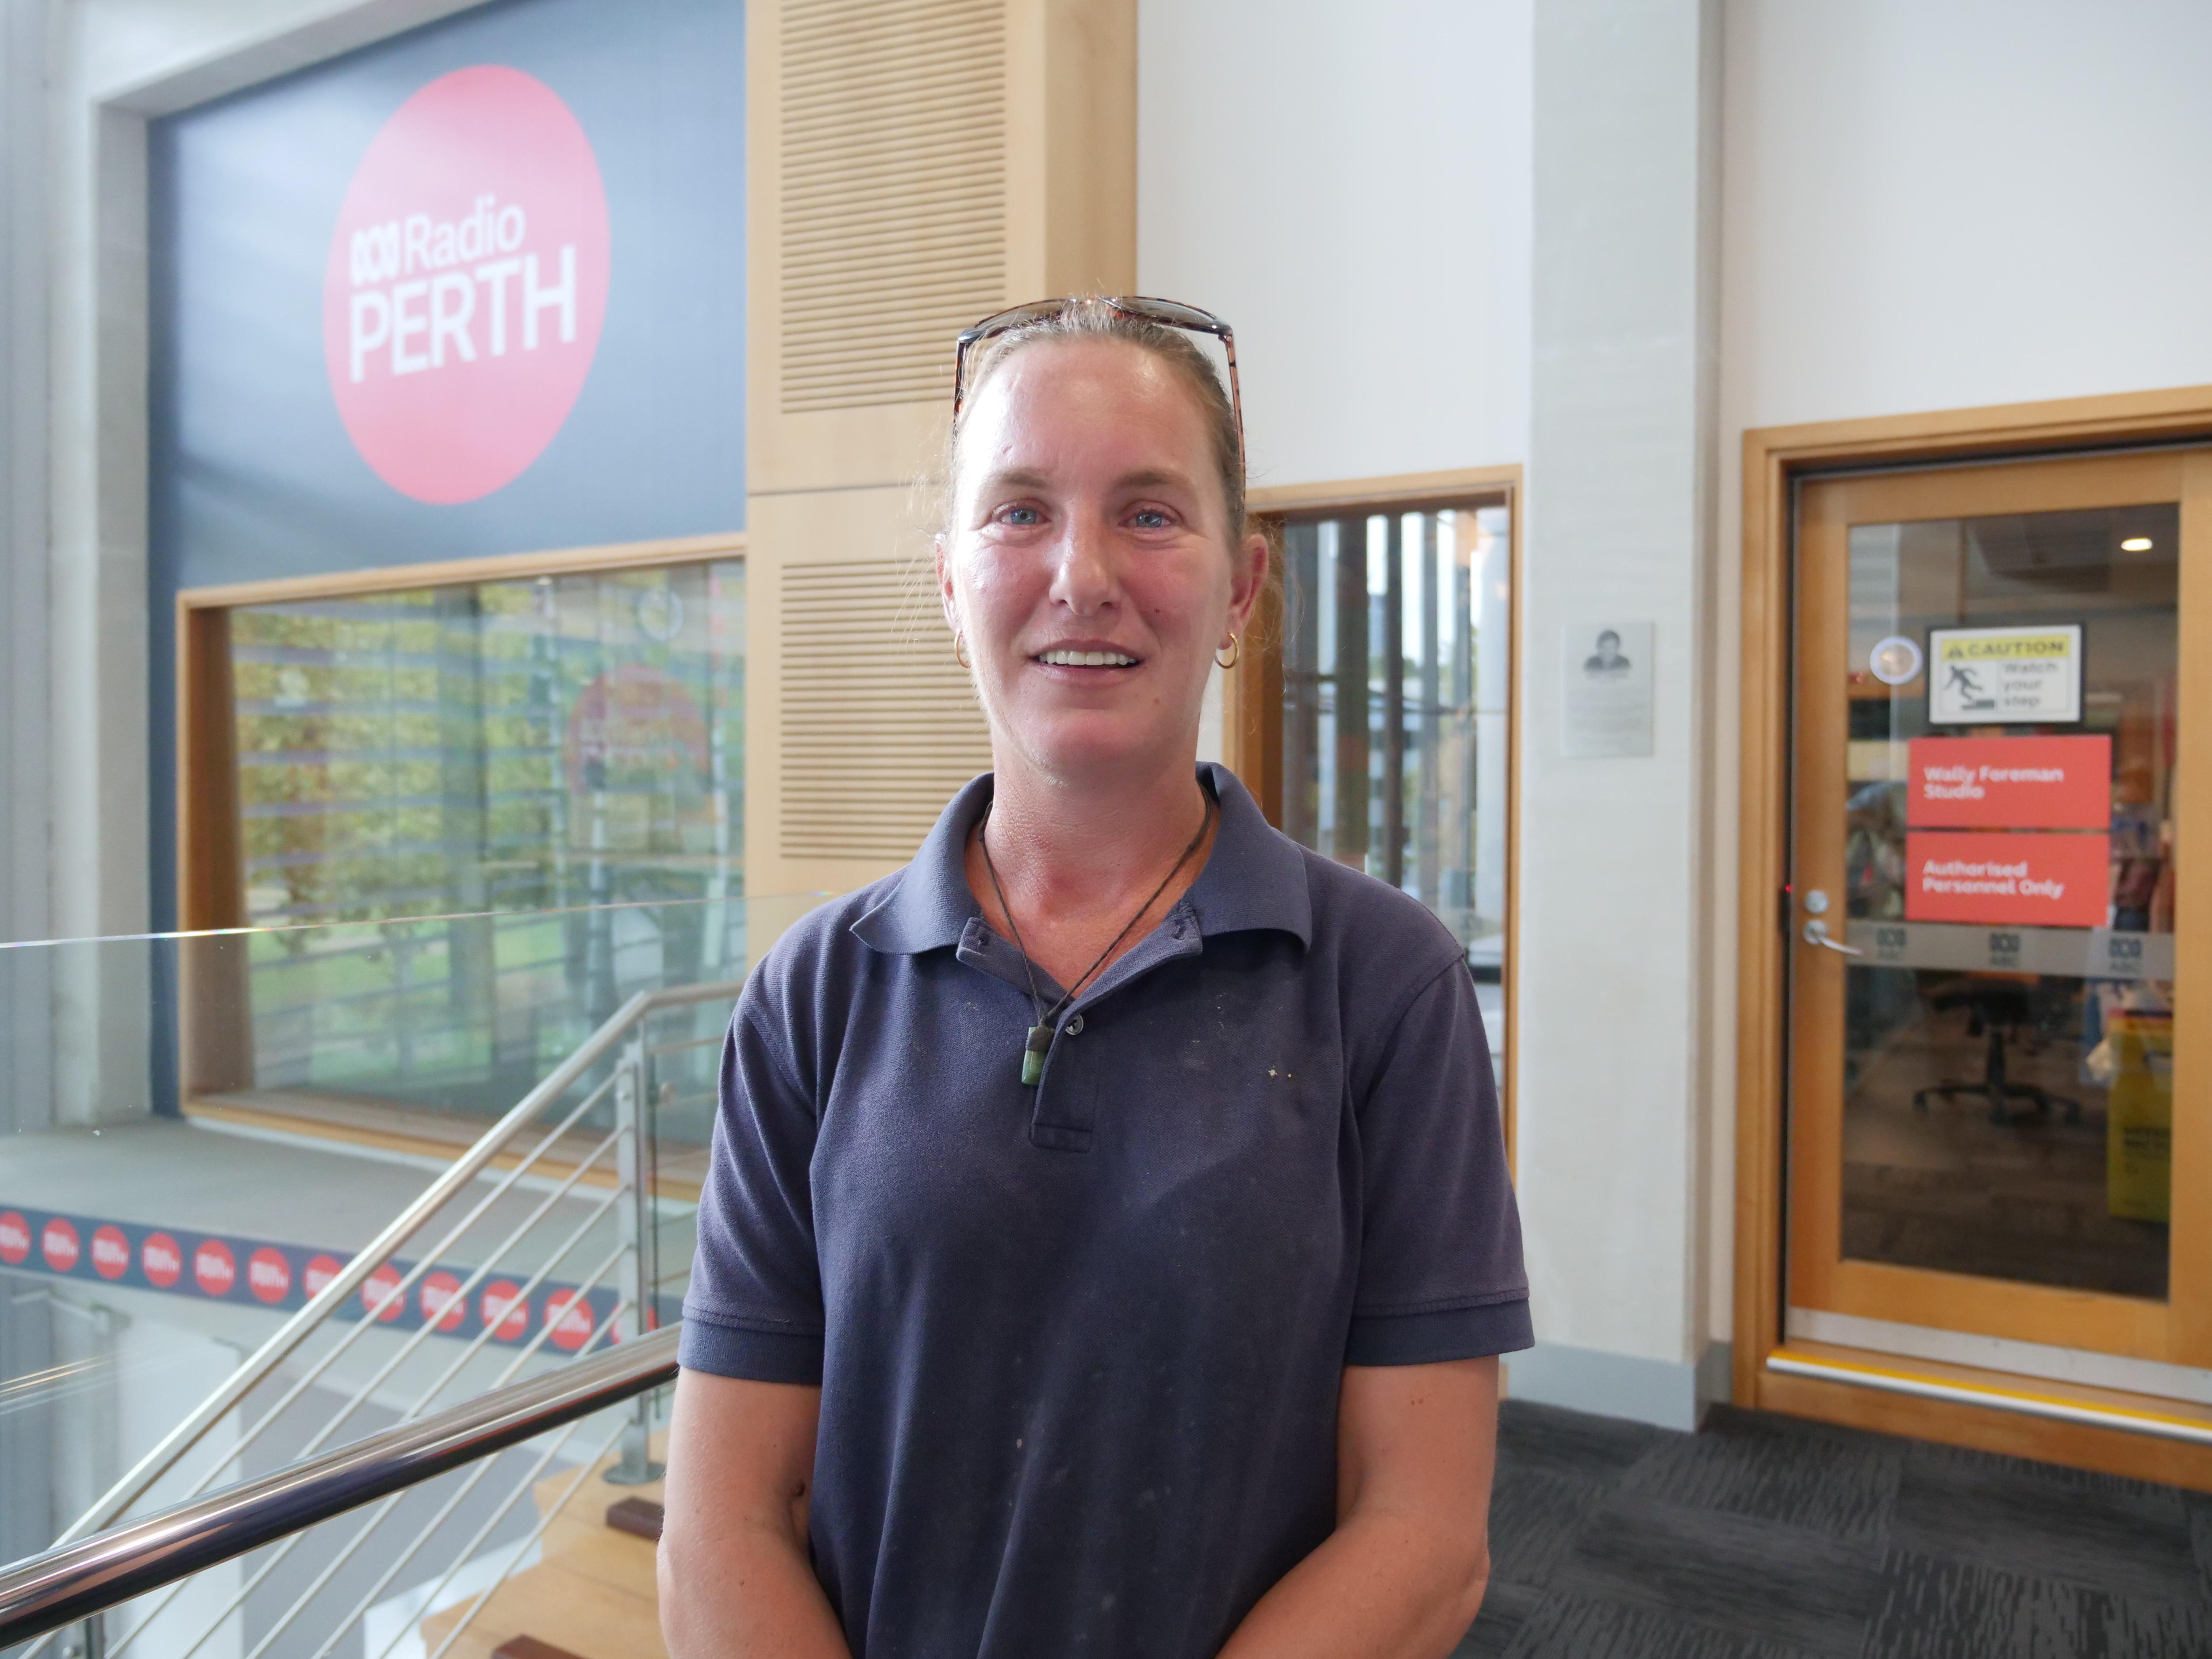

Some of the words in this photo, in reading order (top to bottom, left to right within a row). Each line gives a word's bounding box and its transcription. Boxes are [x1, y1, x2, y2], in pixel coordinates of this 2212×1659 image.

[403, 192, 526, 275] Radio
[350, 243, 576, 384] PERTH
[1967, 641, 2064, 657] CAUTION
[1979, 765, 2065, 782] Foreman
[1923, 783, 1985, 799] Studio
[1922, 877, 2016, 895] Personnel
[2019, 878, 2065, 900] Only
